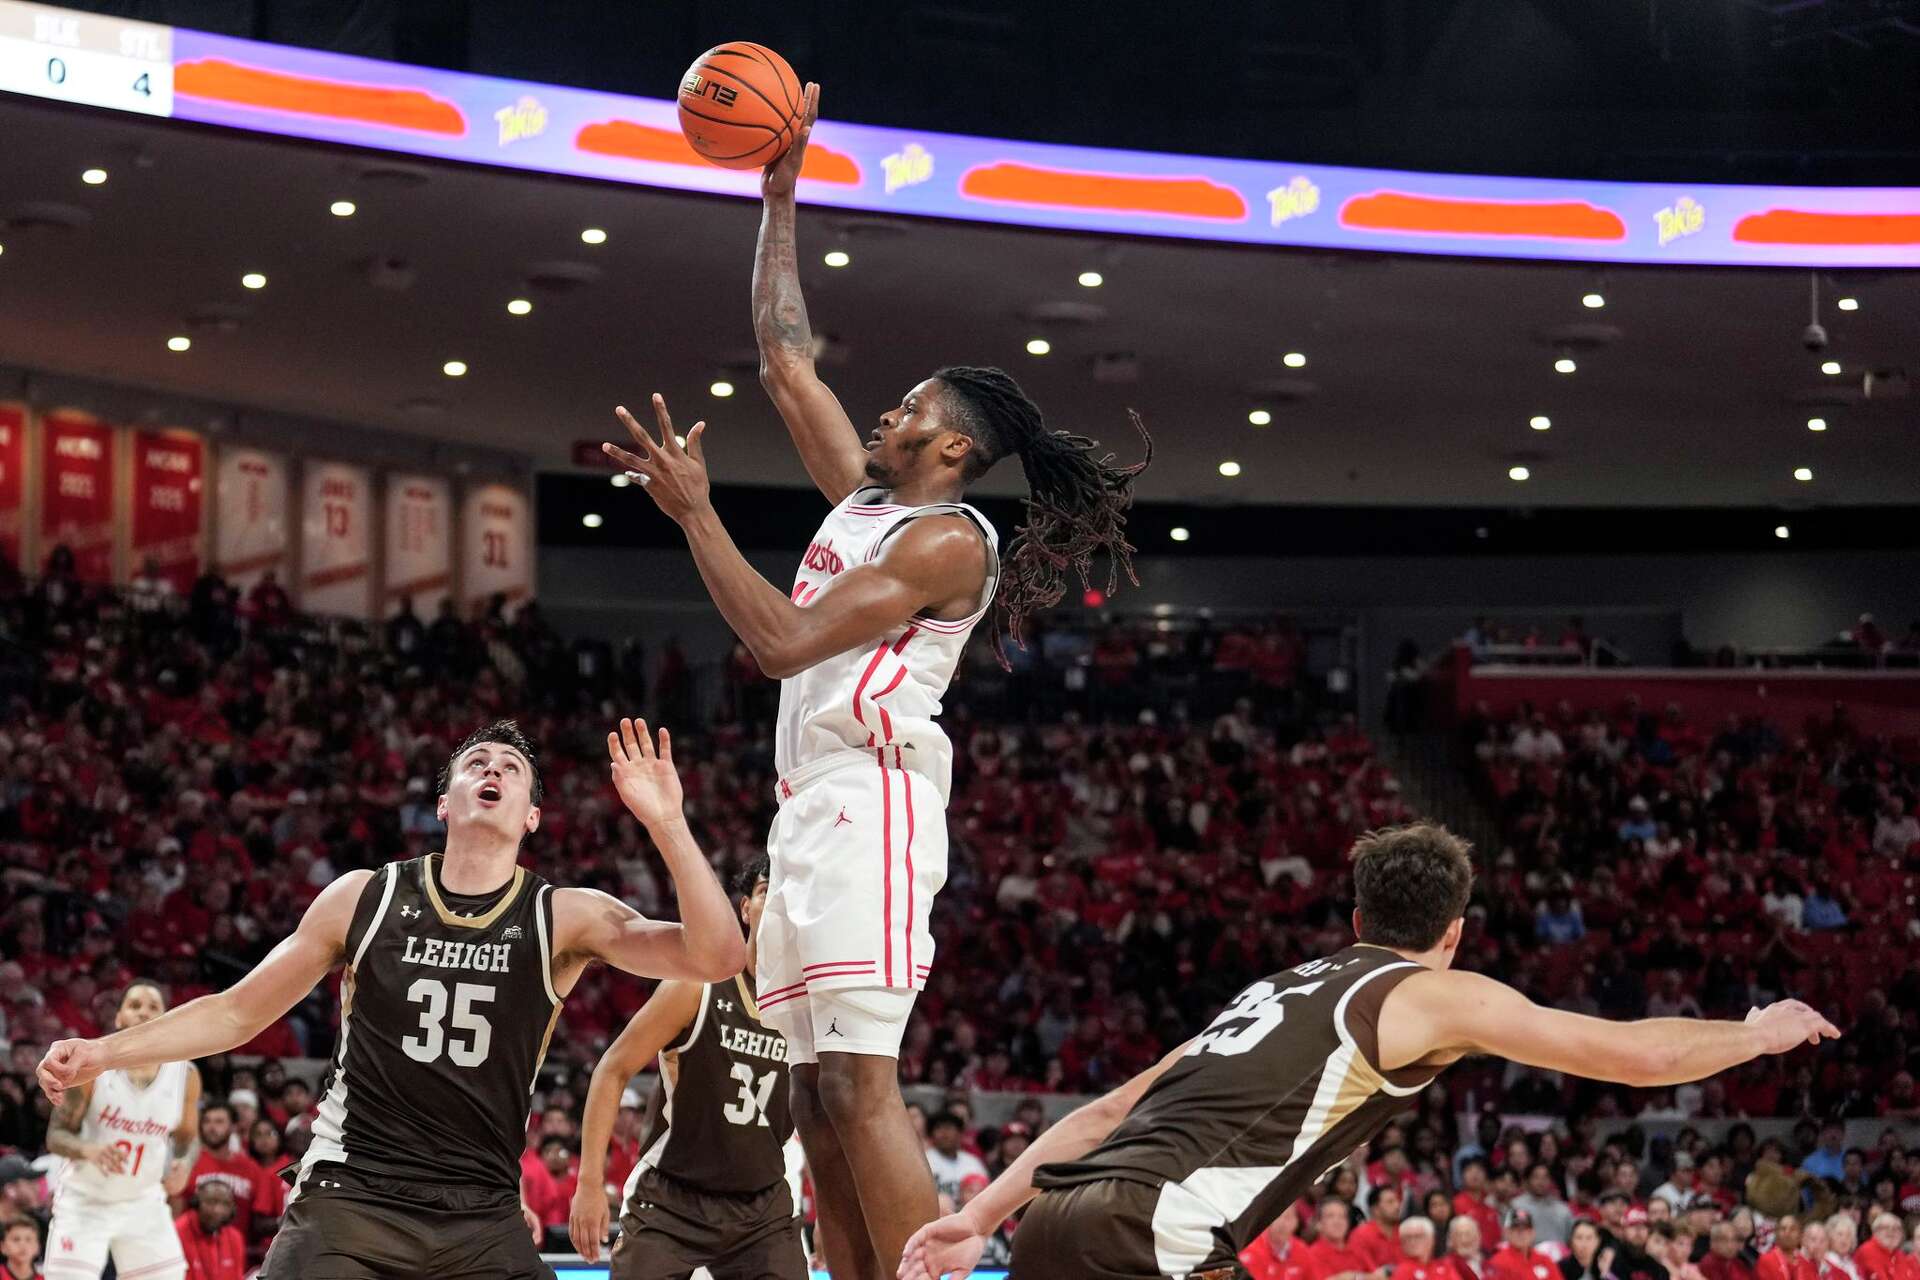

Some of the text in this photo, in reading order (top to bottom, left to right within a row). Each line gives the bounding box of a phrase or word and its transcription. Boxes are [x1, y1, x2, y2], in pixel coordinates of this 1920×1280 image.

[48, 57, 152, 96] 0 4
[401, 936, 512, 973] LEHIGH
[402, 978, 496, 1068] 35
[720, 1024, 788, 1063] LEHIG
[723, 1061, 778, 1127] 31
[97, 1104, 168, 1136] Houston
